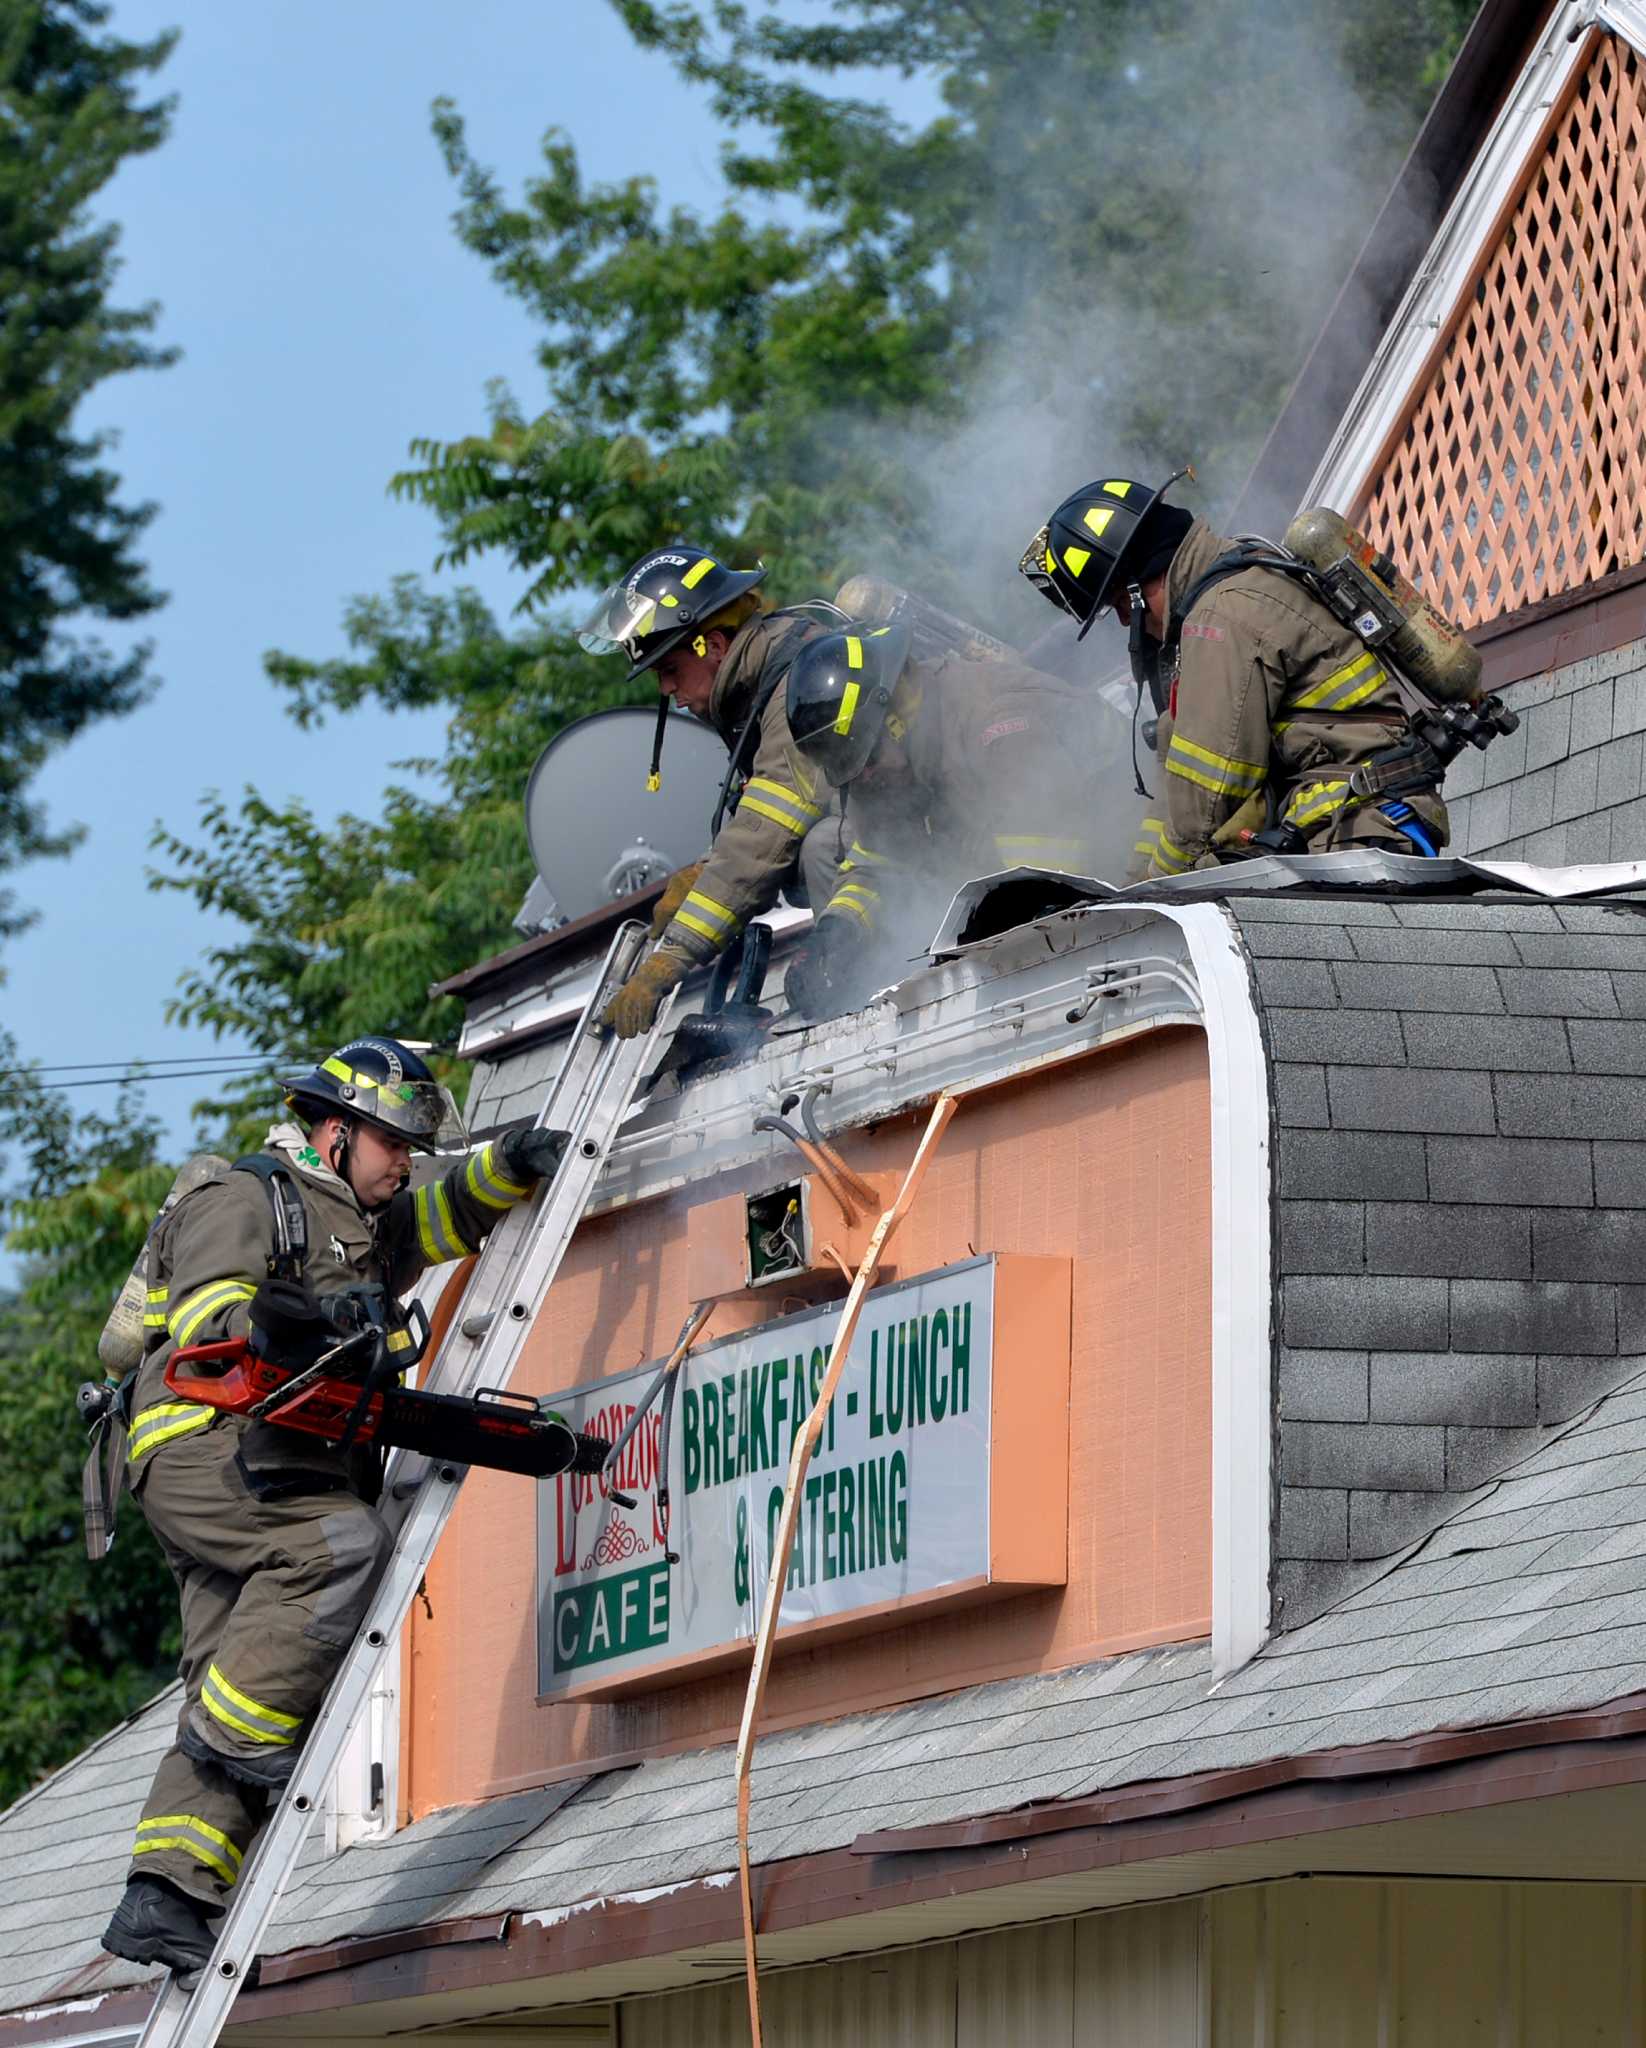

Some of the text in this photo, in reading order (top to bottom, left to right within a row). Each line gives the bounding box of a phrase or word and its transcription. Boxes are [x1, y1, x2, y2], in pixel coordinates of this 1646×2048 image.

[869, 1301, 972, 1440] LUNCH
[734, 1450, 908, 1607] & CATERING
[556, 1570, 669, 1662] CAFE
